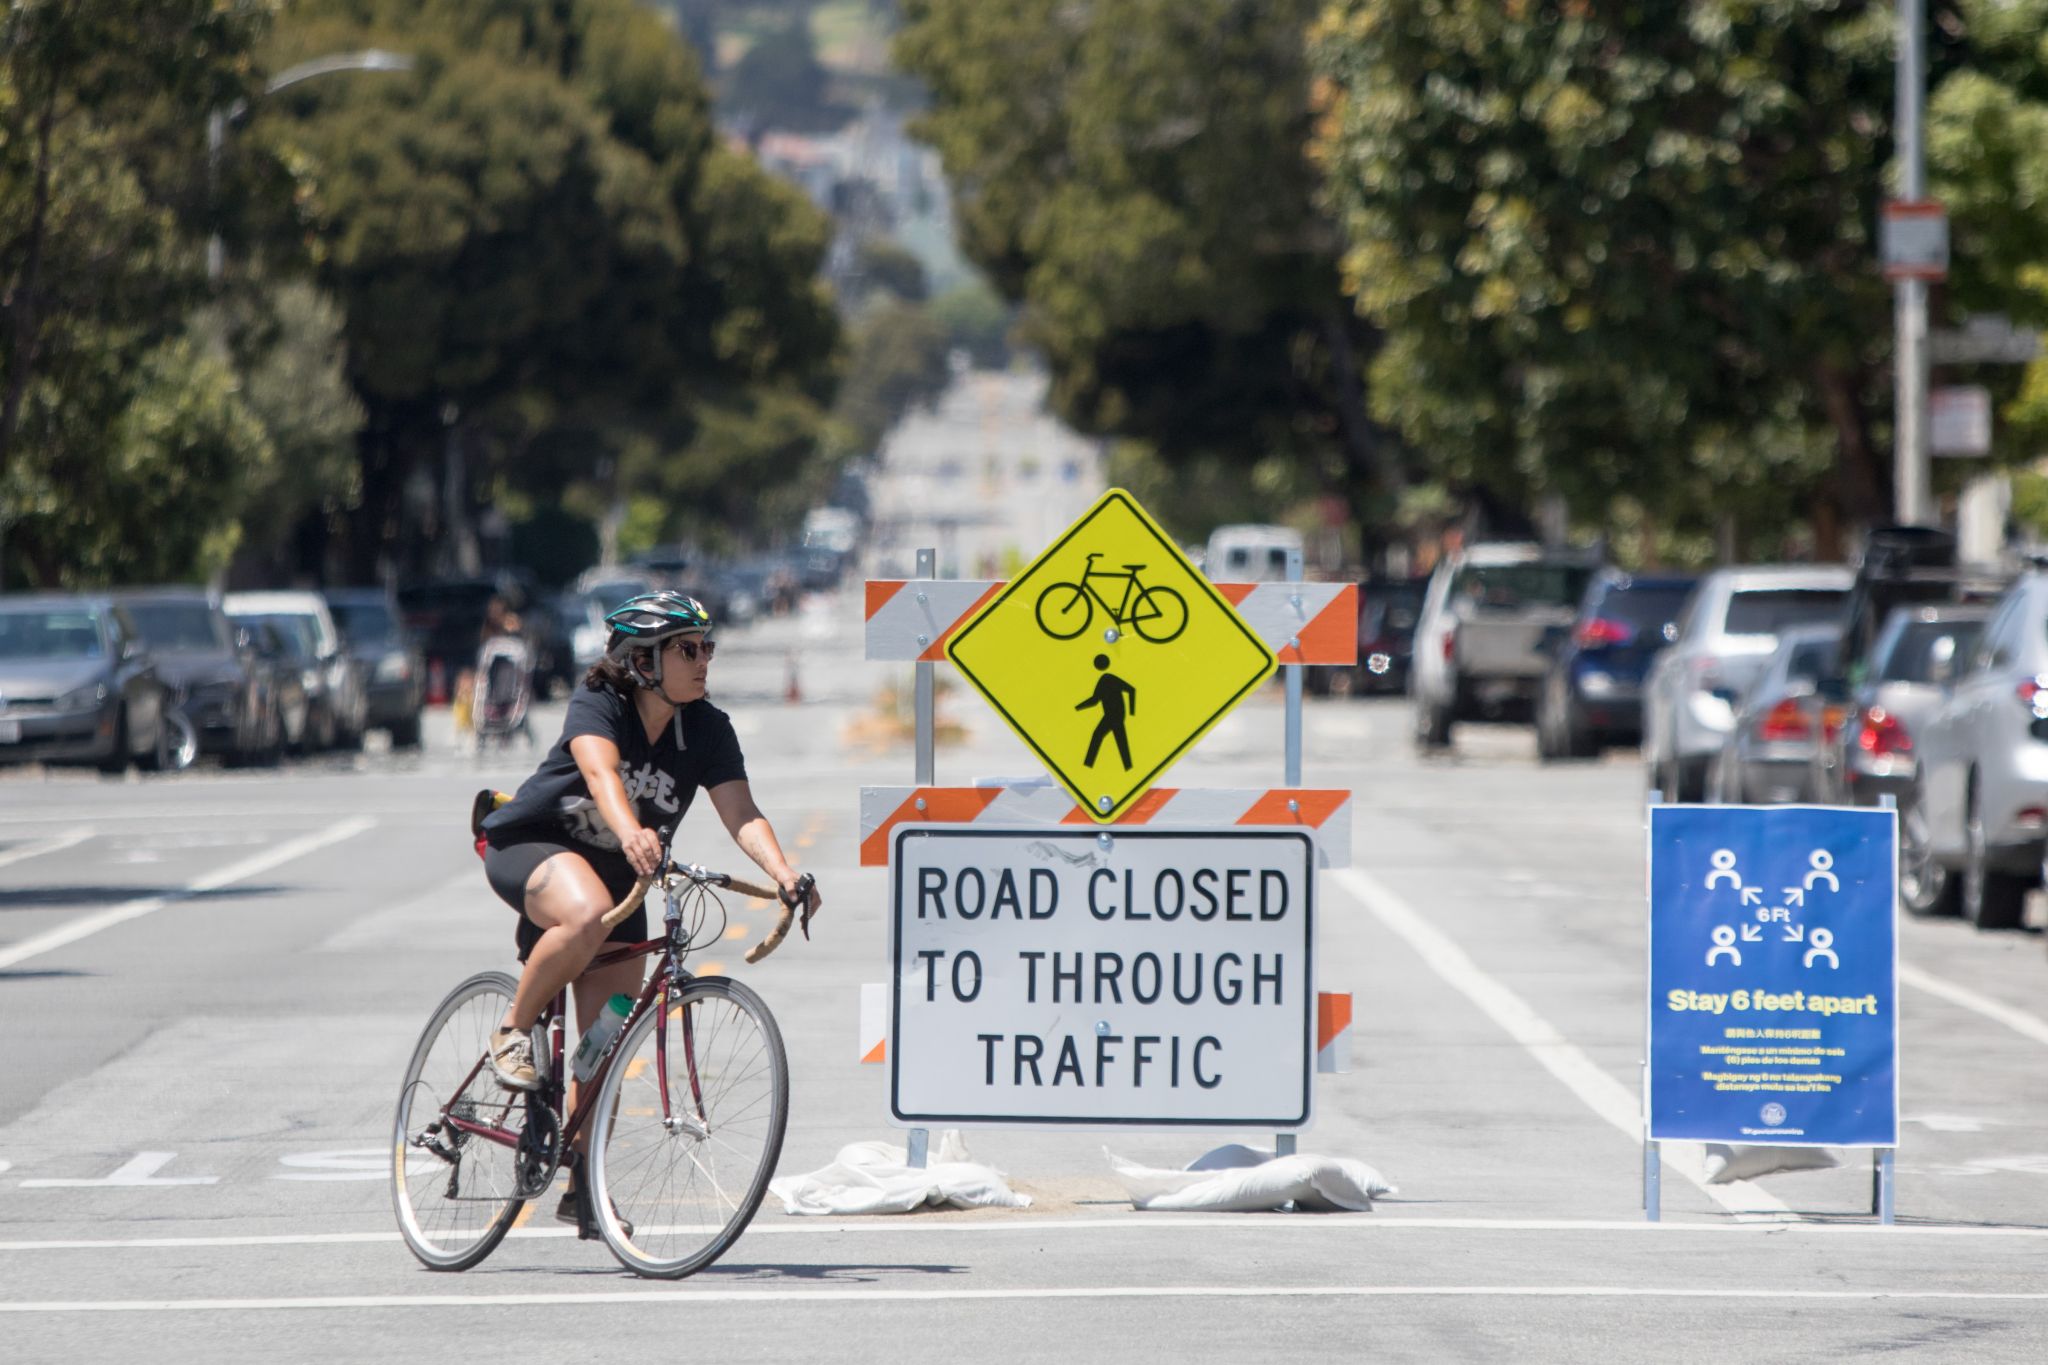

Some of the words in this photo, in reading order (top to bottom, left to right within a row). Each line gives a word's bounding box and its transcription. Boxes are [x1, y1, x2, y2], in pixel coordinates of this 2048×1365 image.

[917, 867, 1059, 920] ROAD
[1088, 868, 1289, 921] CLOSED
[1756, 907, 1770, 922] 6
[1771, 906, 1791, 922] Ft
[918, 950, 983, 1002] TO
[1019, 951, 1283, 1006] THROUGH
[1668, 989, 1729, 1015] Stay
[1731, 990, 1750, 1011] 6
[1753, 989, 1805, 1012] feet
[1808, 994, 1878, 1017] apart
[977, 1033, 1223, 1089] TRAFFIC
